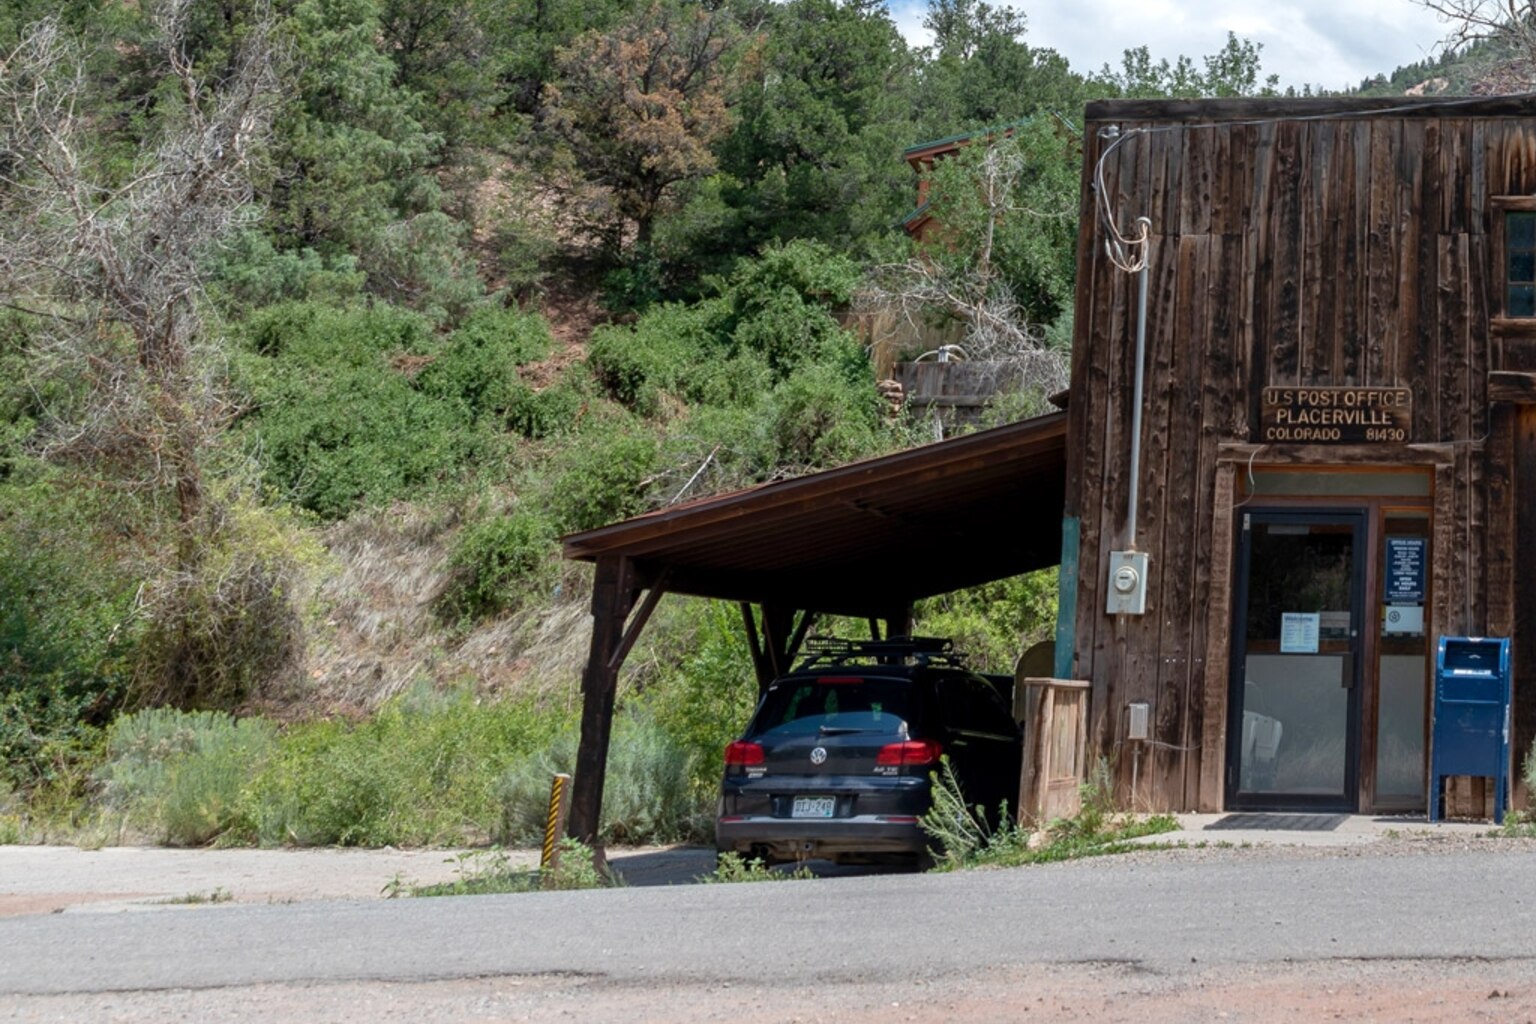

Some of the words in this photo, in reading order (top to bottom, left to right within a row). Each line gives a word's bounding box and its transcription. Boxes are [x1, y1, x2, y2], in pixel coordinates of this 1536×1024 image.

[1298, 390, 1340, 406] POST
[1344, 390, 1406, 407] OFFICE
[1276, 408, 1393, 425] PLACERVILLE
[1266, 426, 1341, 441] COLORADO
[1366, 427, 1405, 442] 81430
